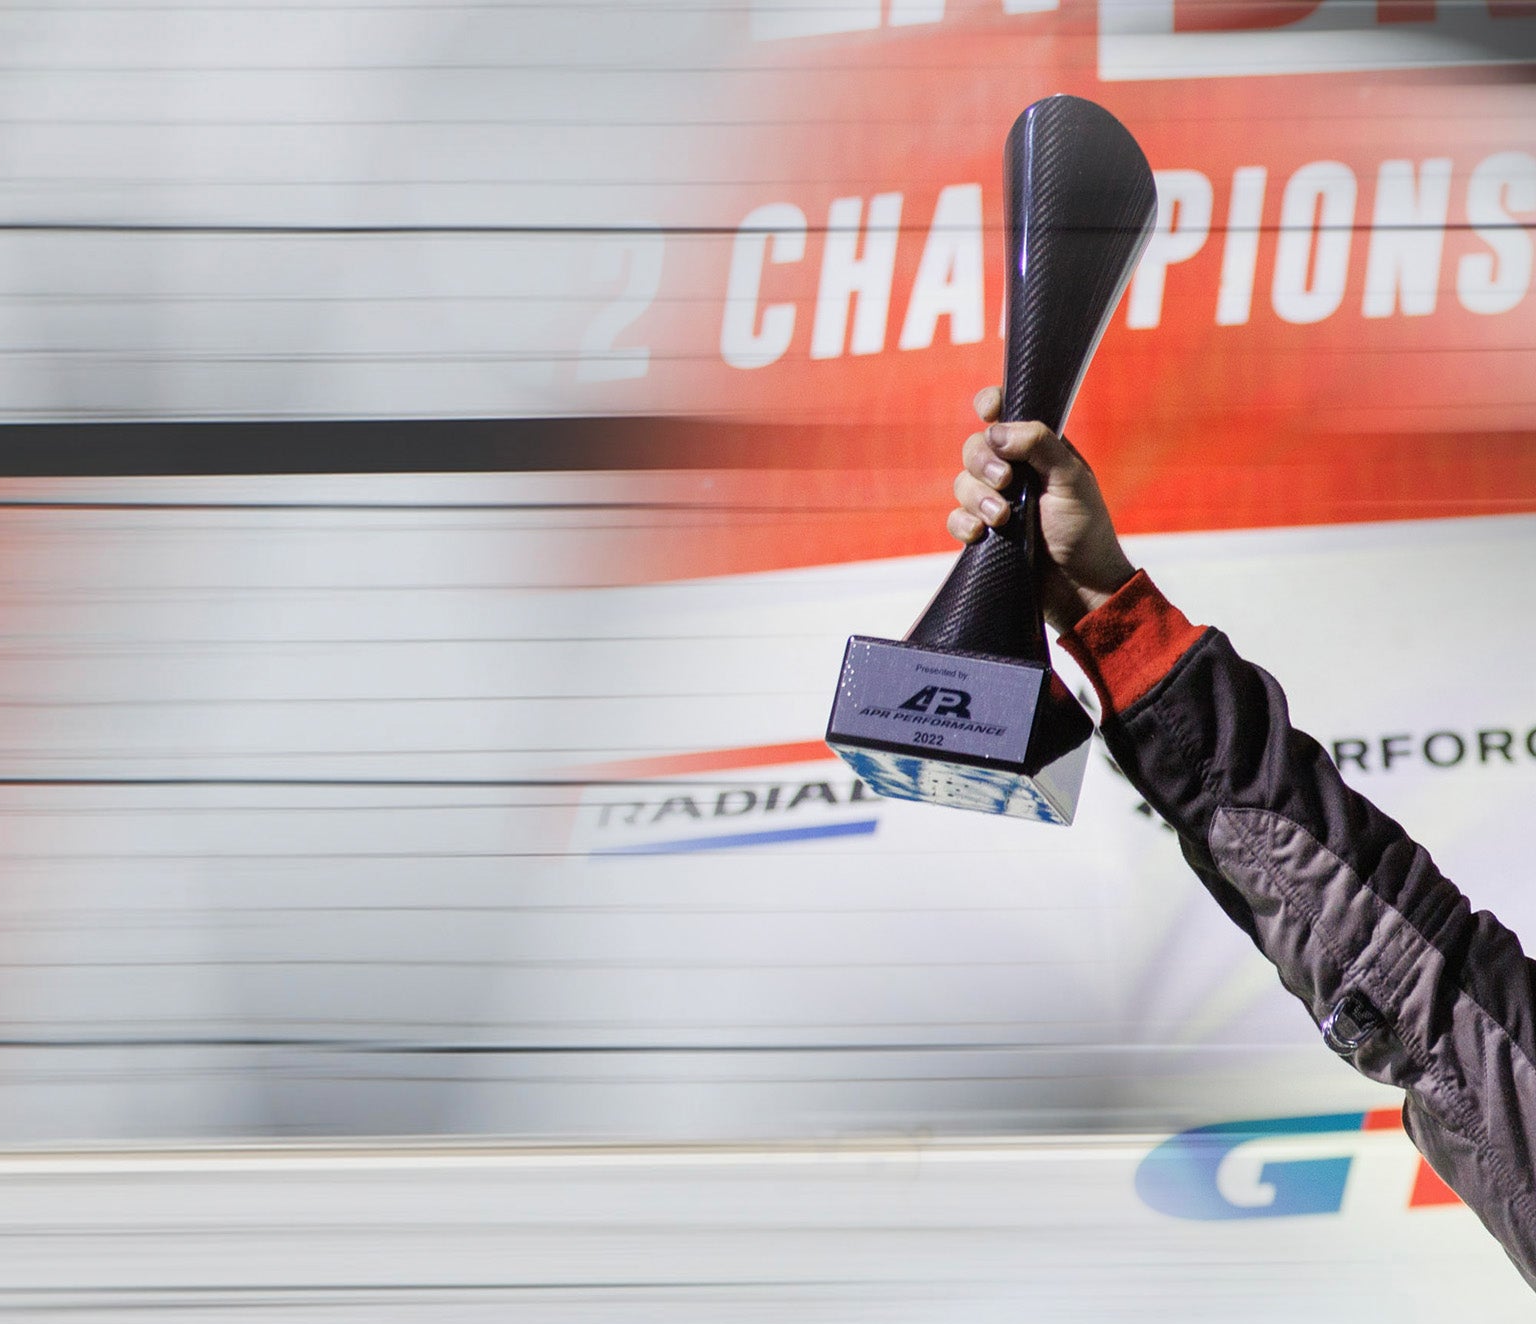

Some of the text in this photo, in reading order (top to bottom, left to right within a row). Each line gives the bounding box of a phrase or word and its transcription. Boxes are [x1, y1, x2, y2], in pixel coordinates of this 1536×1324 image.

[915, 664, 956, 678] Presented
[859, 707, 1008, 738] APR PERFORMANCE
[914, 731, 945, 747] 2022
